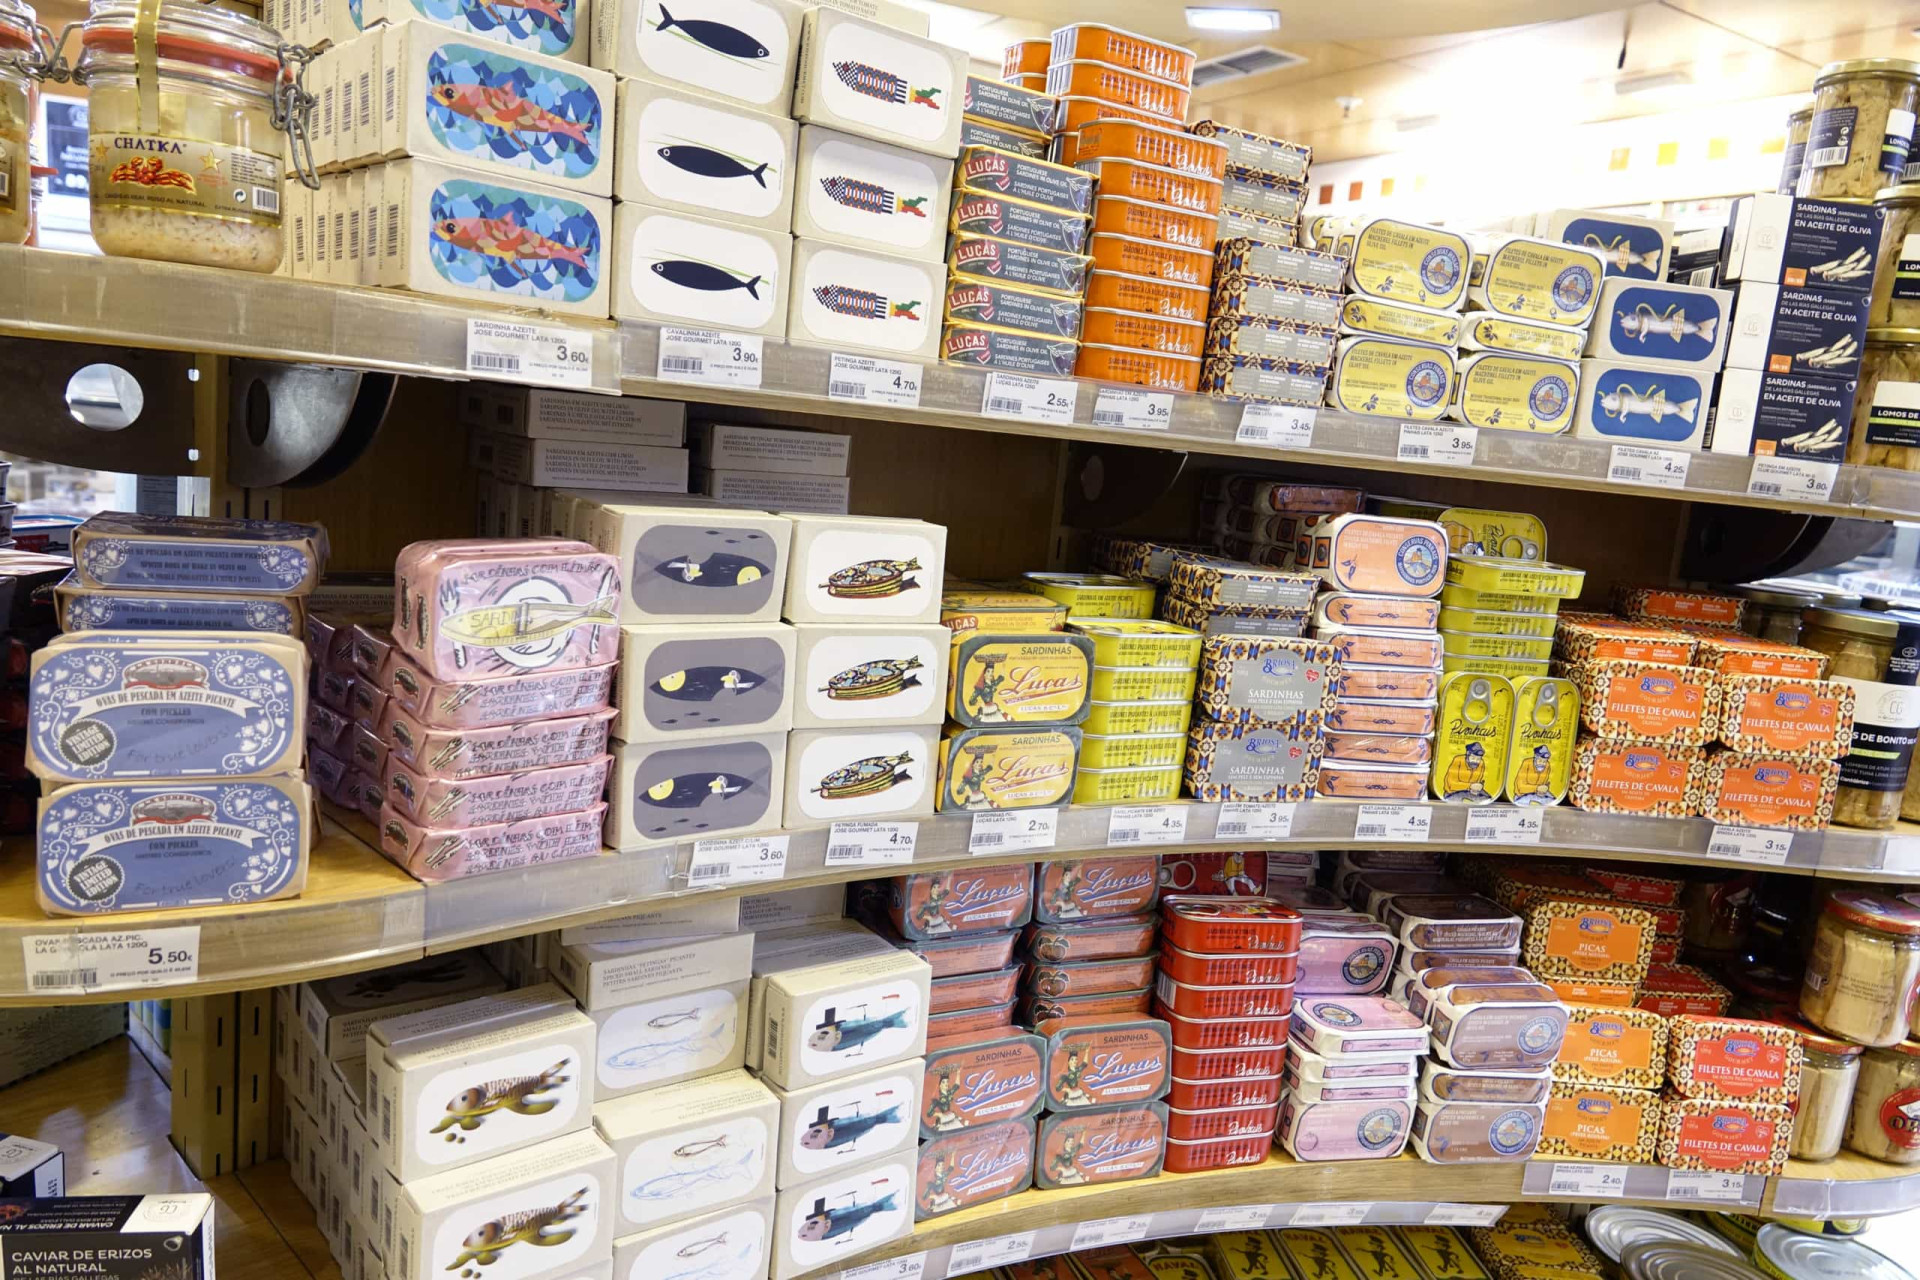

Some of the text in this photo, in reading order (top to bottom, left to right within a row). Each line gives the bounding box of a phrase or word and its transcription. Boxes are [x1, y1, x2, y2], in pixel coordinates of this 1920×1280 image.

[114, 137, 182, 154] CHATKA
[968, 159, 1006, 175] LUCAS
[960, 202, 998, 217] LUCAS
[1797, 203, 1837, 215] SARDINAS
[1794, 220, 1872, 236] EN ACEITE DE OLIVA
[958, 243, 996, 258] LUCAS
[952, 290, 989, 304] LUCAS
[1782, 291, 1822, 303] SARDINAS
[1779, 307, 1857, 322] EN ACEITE DE OLIVA
[474, 321, 537, 335] SARDINHA AZEITE
[666, 329, 700, 337] CAVALINHA
[495, 331, 530, 341] GOURMET
[532, 335, 549, 343] LATA
[683, 337, 713, 345] GOURMET
[948, 334, 986, 351] LUCAS
[1766, 377, 1806, 389] SARDINAS
[1764, 392, 1841, 408] EN ACEITE DE OLIVA
[1878, 409, 1905, 418] LOMOS
[1021, 646, 1072, 655] SARDINHAS
[96, 690, 236, 708] OVAS DE PESCADA EM AZEITE PICANTE
[1248, 688, 1305, 700] SARDINHAS
[1611, 702, 1696, 720] FILETES DE CAVALA
[1746, 718, 1831, 733] FILETES DE CAVALA
[1012, 736, 1061, 746] SARDINHAS
[1860, 732, 1907, 745] DE BONITO
[1229, 766, 1286, 775] SARDINHAS
[1595, 778, 1680, 794] FILETES DE CAVALA
[1724, 792, 1811, 808] FILETES DE CAVALA
[104, 825, 243, 844] OVAS DE PESCADA EM AZEITE PICANTE
[100, 943, 123, 951] LATA
[127, 941, 148, 949] 120G
[1579, 943, 1607, 954] PICAS
[1103, 1033, 1149, 1045] SARDINHAS
[976, 1048, 1022, 1063] SARDINHAS
[1589, 1048, 1618, 1060] PICAS
[1698, 1064, 1780, 1080] FILETES DE CAVALA
[1101, 1114, 1145, 1127] SARDINHAS
[1577, 1123, 1605, 1135] PICAS
[1684, 1139, 1767, 1153] FILETES DE CAVALA
[11, 1248, 152, 1262] CAVIAR DE ERIZOS
[12, 1262, 107, 1275] AL NATURAL
